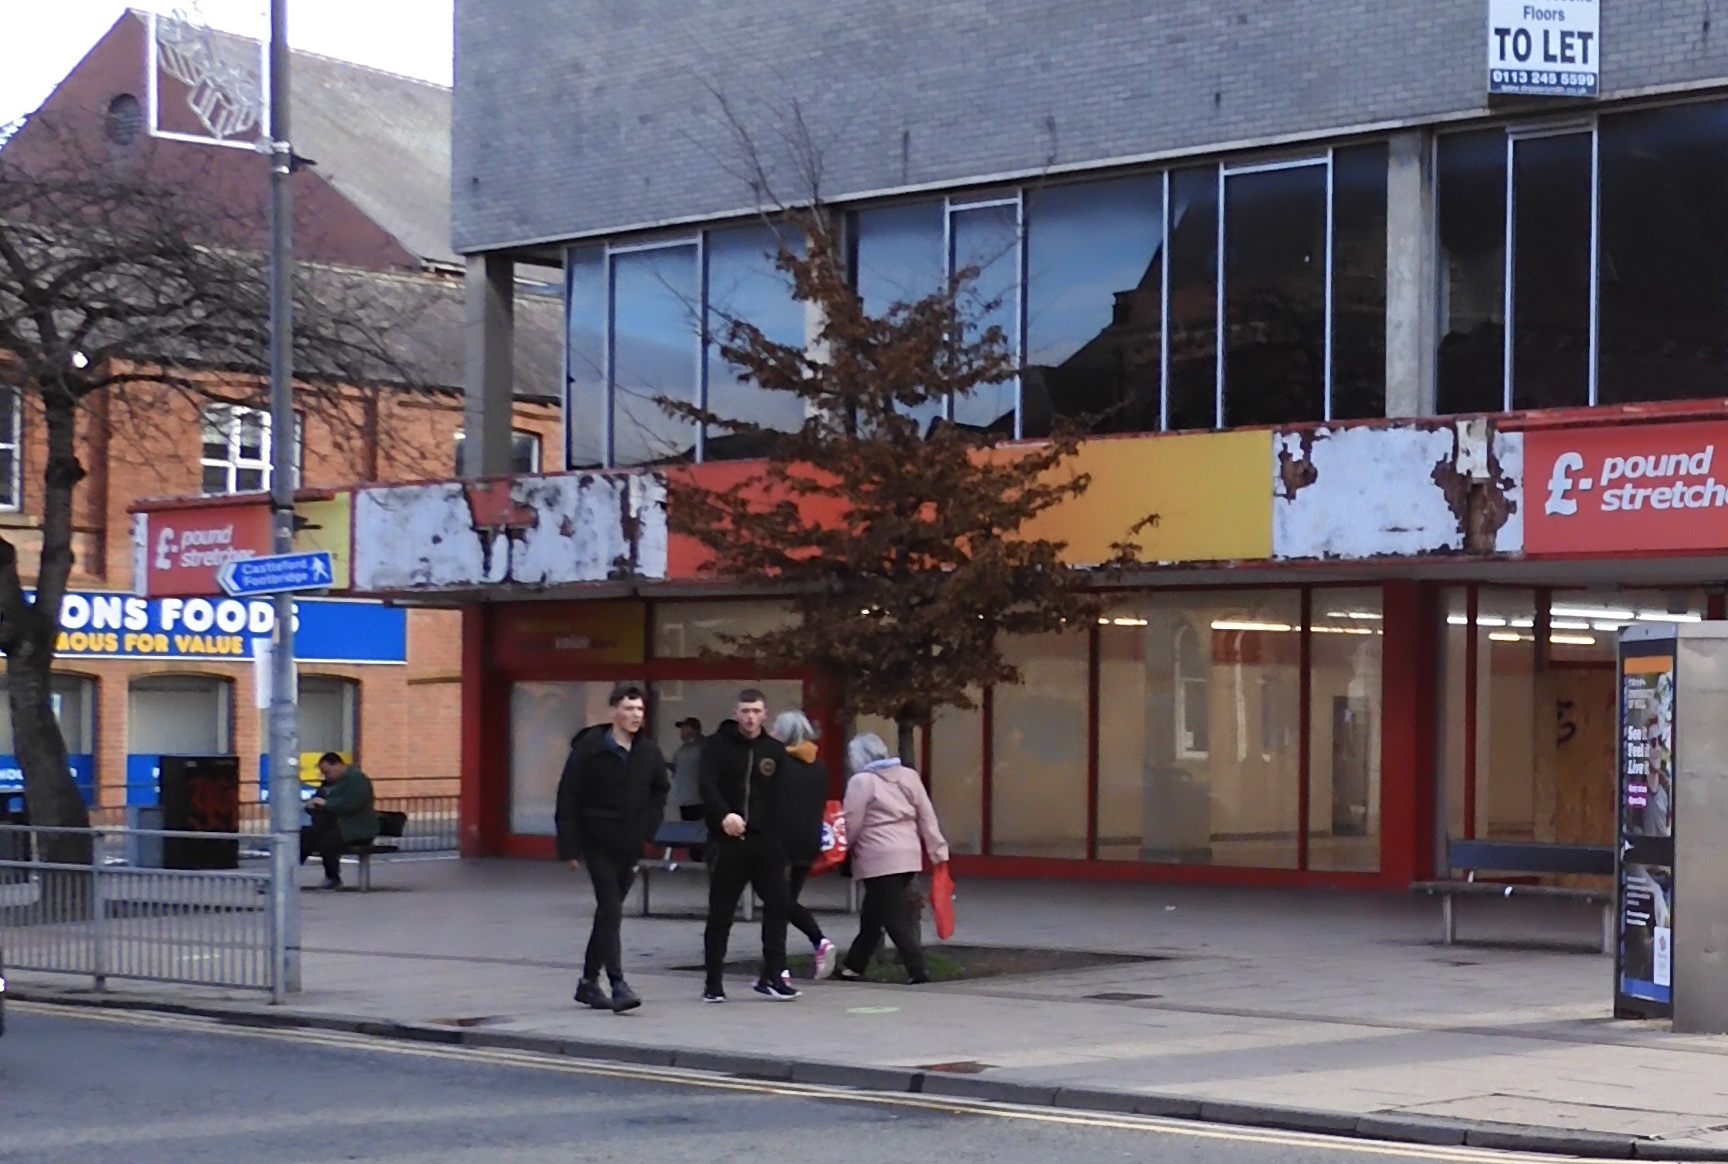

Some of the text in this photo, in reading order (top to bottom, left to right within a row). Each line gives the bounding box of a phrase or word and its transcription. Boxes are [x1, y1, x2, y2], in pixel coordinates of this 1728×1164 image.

[1523, 5, 1566, 22] Floors
[1494, 27, 1594, 65] TO LET
[1492, 70, 1528, 83] 0113
[1601, 444, 1714, 487] pound
[181, 524, 233, 550] pound
[60, 594, 148, 630] ONS
[124, 633, 169, 652] FOR
[175, 635, 244, 654] VALUE
